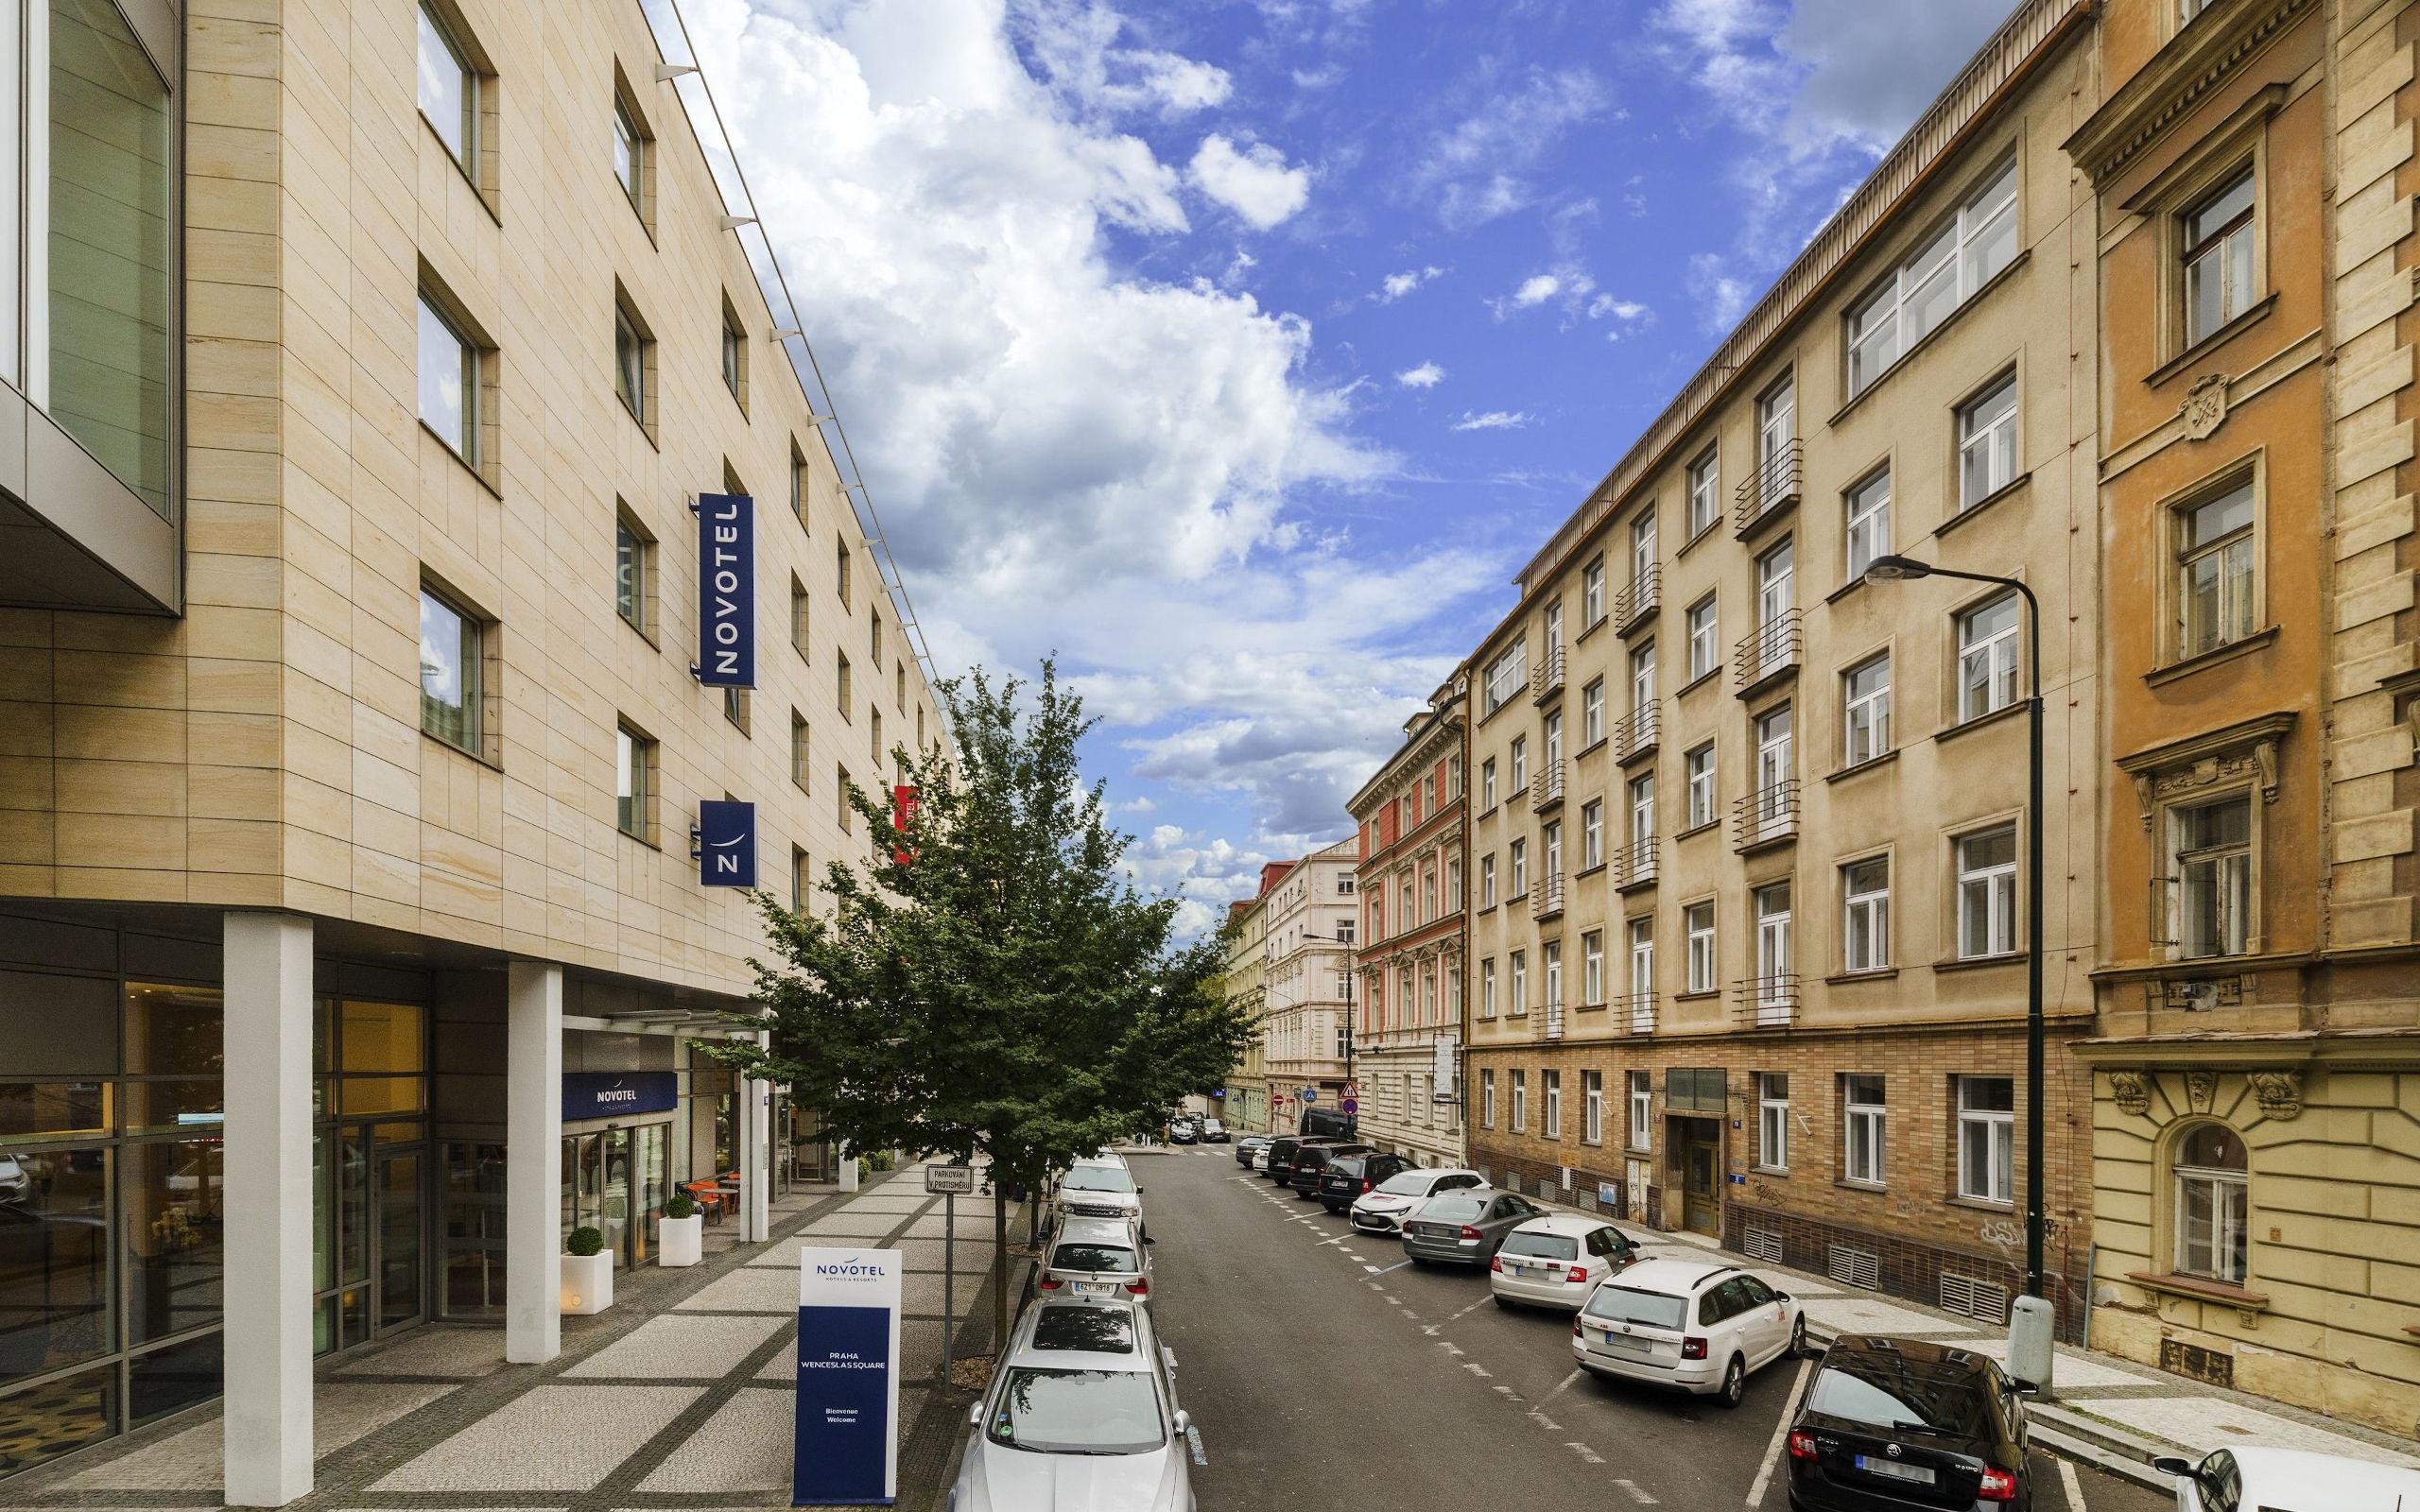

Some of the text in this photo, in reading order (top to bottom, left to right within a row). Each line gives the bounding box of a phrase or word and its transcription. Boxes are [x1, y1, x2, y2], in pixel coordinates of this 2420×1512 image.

[715, 504, 738, 675] NOVOTEL
[717, 853, 737, 874] N
[596, 1090, 637, 1103] NOVOTEL
[934, 1170, 965, 1178] PARKOVÁNÍ
[934, 1180, 970, 1189] PROTISMĚRU
[817, 1265, 886, 1276] NOVOTEL
